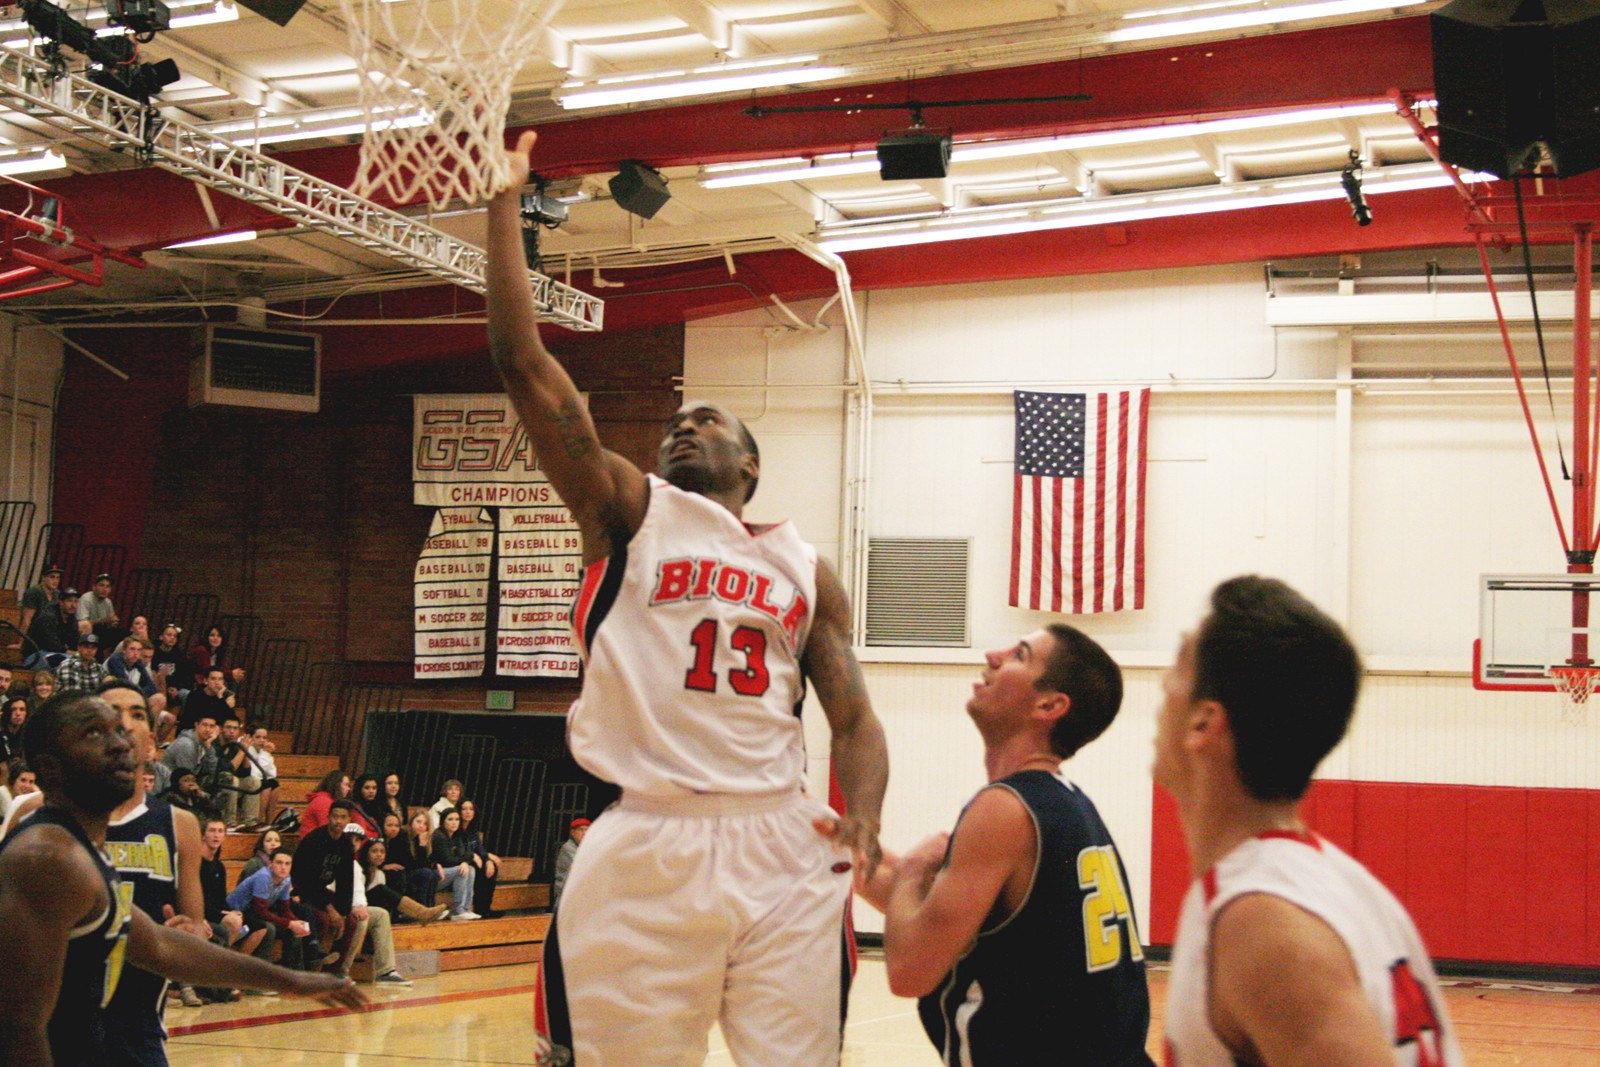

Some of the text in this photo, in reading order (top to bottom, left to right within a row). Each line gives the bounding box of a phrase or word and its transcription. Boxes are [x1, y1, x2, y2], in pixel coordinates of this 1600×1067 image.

[416, 410, 541, 471] GSA
[451, 487, 549, 502] CHAMPIONS
[513, 514, 566, 524] VOLLEYBALL
[425, 539, 469, 550] ASEBALL
[504, 538, 578, 549] BASEBALL 99
[419, 563, 473, 575] BASEBALL
[506, 563, 575, 574] BASEBALL 01
[422, 588, 470, 600] SOFTBALL
[501, 589, 507, 599] M
[508, 588, 559, 599] BASKETBALL
[418, 614, 426, 624] M
[430, 612, 466, 623] SOCCER
[512, 612, 569, 623] W SOCCER 04
[428, 636, 471, 648] BASEBALL
[498, 636, 571, 646] W CROSS COUNTRY
[684, 618, 770, 697] 13
[422, 662, 451, 672] CROSS
[498, 659, 506, 669] W
[506, 660, 532, 670] TRACK
[541, 660, 568, 670] FIELD
[103, 834, 174, 881] ERRA
